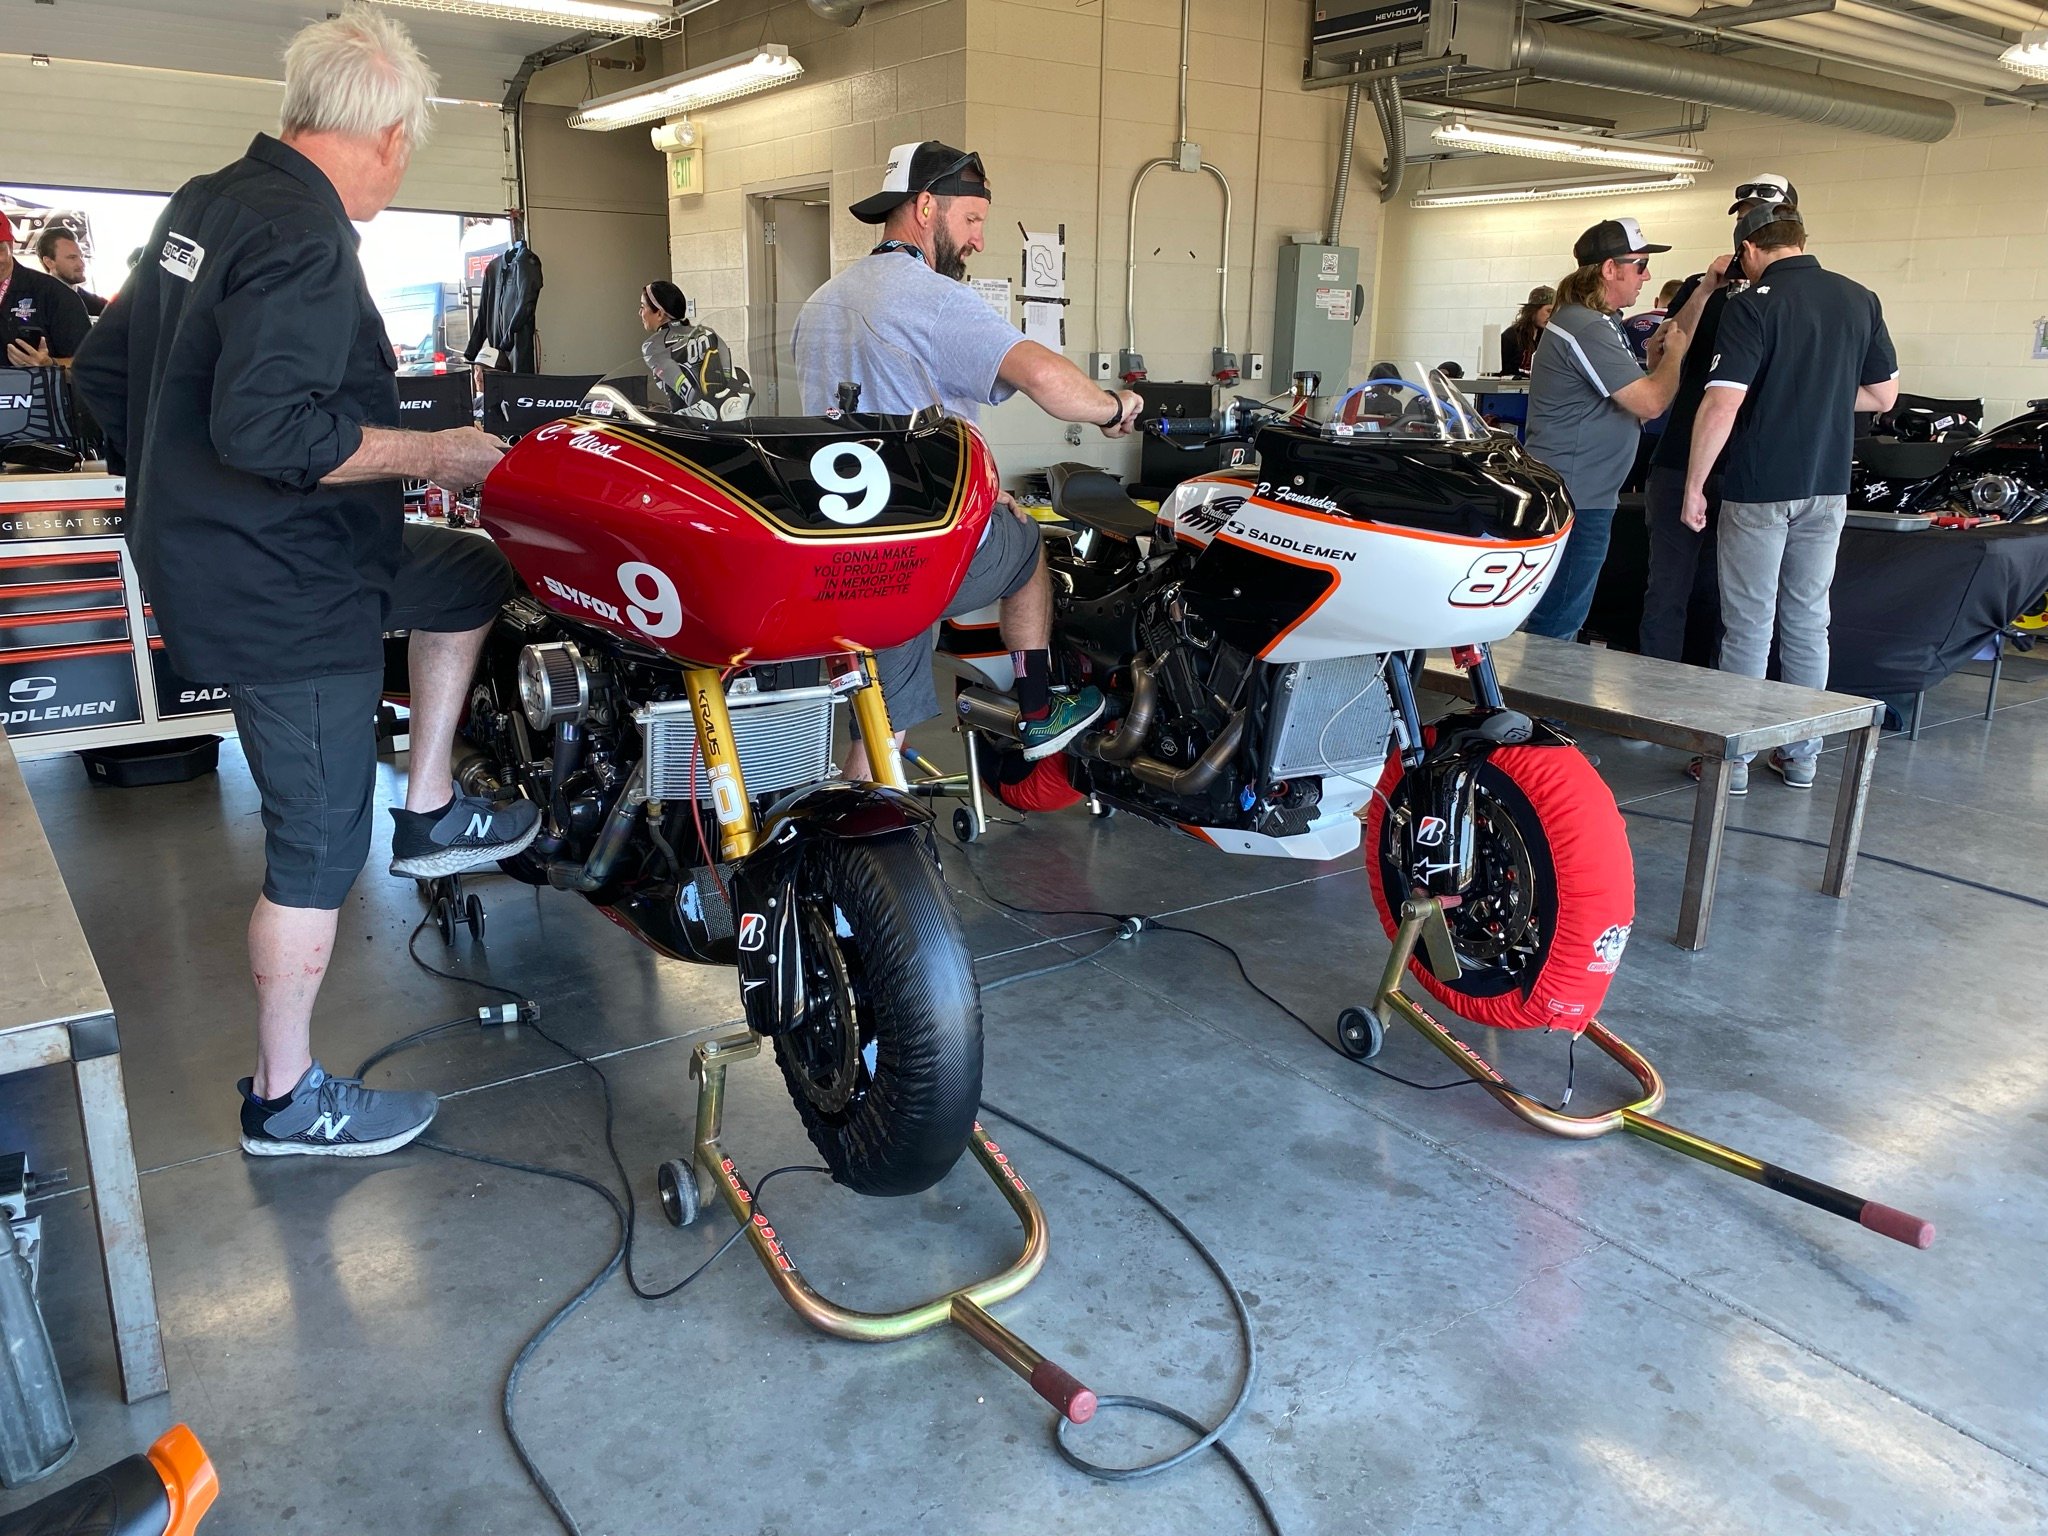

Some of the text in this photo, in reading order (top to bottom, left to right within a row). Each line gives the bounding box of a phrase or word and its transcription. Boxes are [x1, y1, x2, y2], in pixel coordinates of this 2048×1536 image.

[1375, 6, 1419, 21] HEVI-DUTY
[675, 156, 692, 189] EXIT
[568, 429, 622, 459] West
[810, 441, 892, 525] 9
[1256, 481, 1345, 514] P. Fernandez
[2, 518, 84, 531] GEL-SEAT
[1201, 502, 1232, 521] Indian
[832, 545, 917, 564] GONNA MAKE
[1248, 528, 1357, 562] SADDLEMEN
[814, 565, 841, 578] YOU
[844, 562, 888, 577] PROUD
[825, 571, 913, 590] IN MEMORY OF
[1448, 543, 1557, 608] 87
[543, 575, 625, 625] SLYFOX
[617, 561, 683, 638] 9
[813, 583, 911, 602] JIM MATCHETTE
[179, 687, 231, 703] SAD
[698, 688, 721, 757] KRAUS
